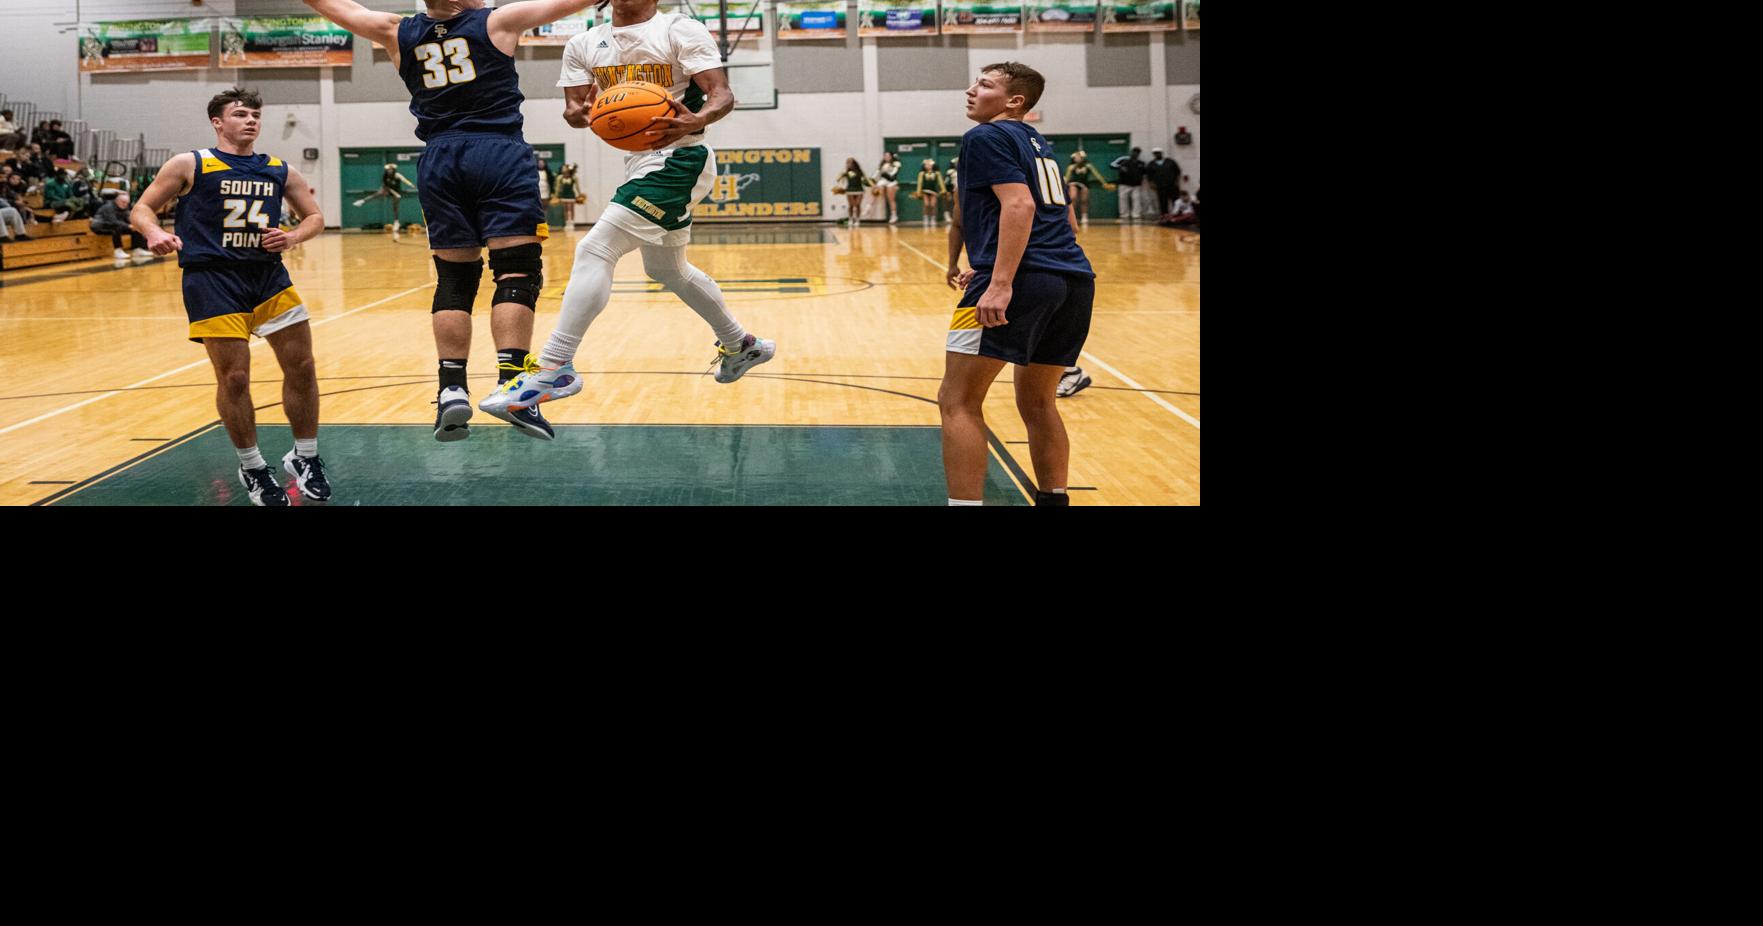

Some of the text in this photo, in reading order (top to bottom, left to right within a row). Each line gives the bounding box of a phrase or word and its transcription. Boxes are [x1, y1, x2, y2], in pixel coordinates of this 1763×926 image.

[302, 33, 348, 46] Stanley
[414, 37, 477, 89] 33
[592, 63, 674, 91] UNTNGTON
[717, 150, 810, 164] INGTON
[220, 180, 274, 196] SOUTH
[709, 174, 741, 203] H
[1035, 157, 1067, 206] 10
[223, 198, 270, 229] 24
[691, 202, 820, 216] HLANDERS
[222, 232, 264, 248] POIN
